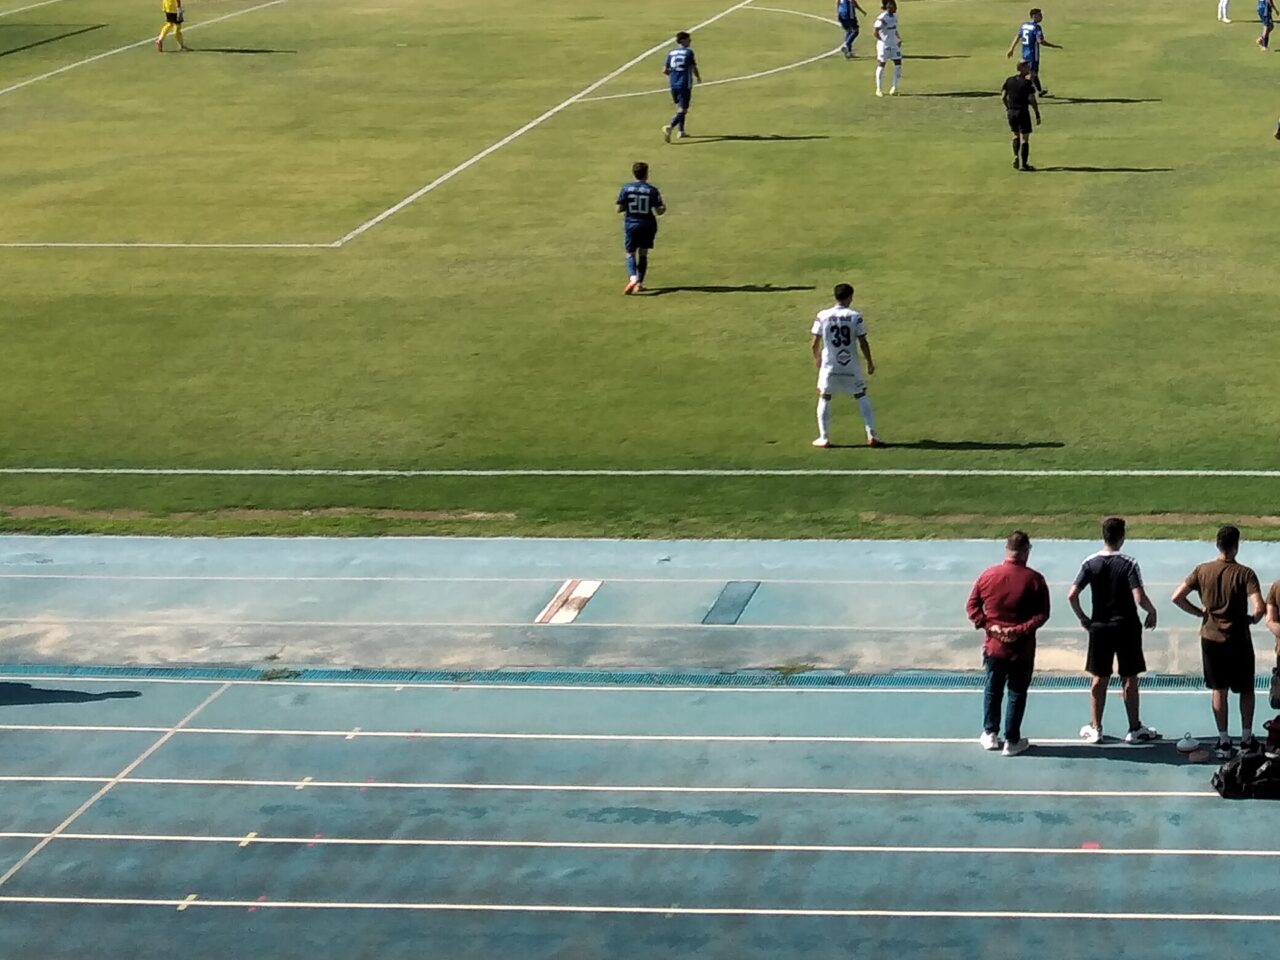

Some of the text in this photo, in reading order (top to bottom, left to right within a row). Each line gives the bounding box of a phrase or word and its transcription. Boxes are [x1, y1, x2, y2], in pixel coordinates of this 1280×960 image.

[1021, 29, 1030, 45] 5
[628, 194, 650, 214] 20
[830, 325, 851, 347] 39
